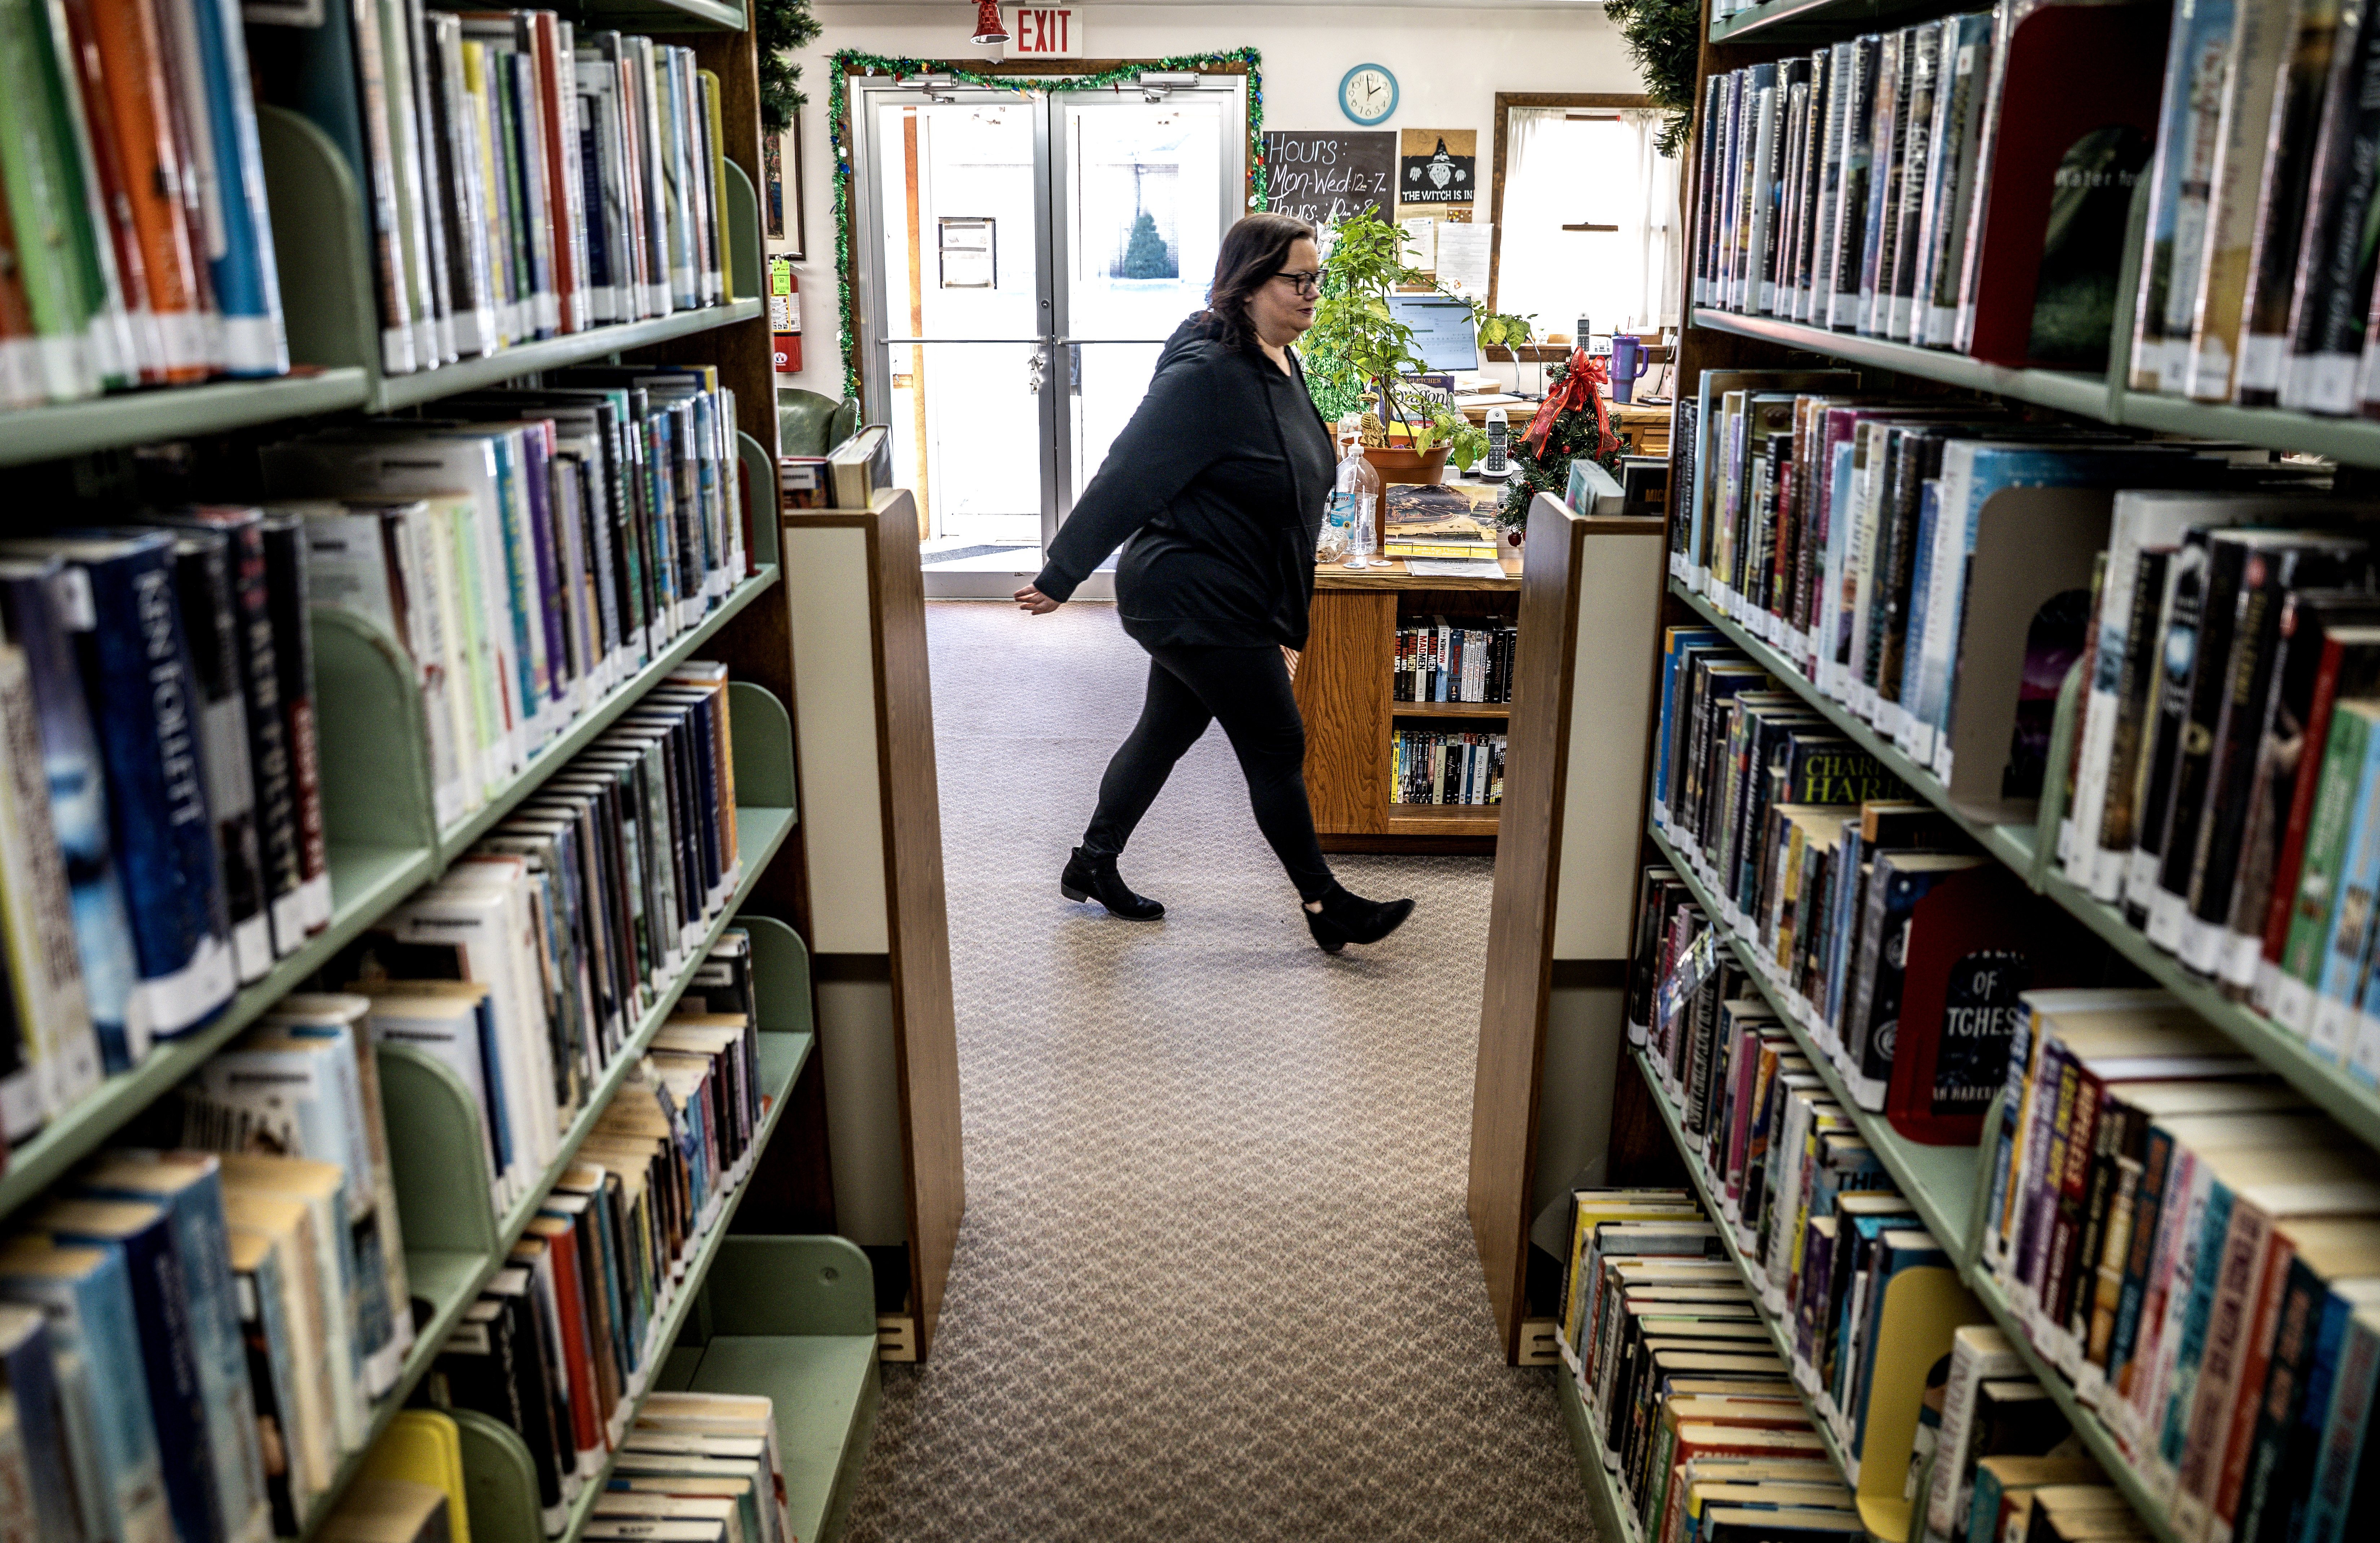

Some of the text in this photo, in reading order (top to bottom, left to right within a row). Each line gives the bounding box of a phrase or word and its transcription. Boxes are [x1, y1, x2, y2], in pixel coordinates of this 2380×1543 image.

[1018, 10, 1071, 52] EXIT
[1351, 99, 1357, 107] 8
[1374, 105, 1380, 114] 5
[1832, 84, 1848, 156] BRETHREN
[1771, 111, 1783, 173] GRISHAM
[1904, 123, 1929, 214] GRISHAM
[1402, 190, 1472, 201] THE WITCH IS IN
[1407, 655, 1416, 672] MEN
[1418, 653, 1426, 670] MEN
[1428, 655, 1436, 671] MEN
[1972, 970, 1998, 1001] OF
[1948, 1007, 2019, 1038] TCHES
[2064, 1081, 2096, 1185] HOPELESS
[2045, 1137, 2066, 1191] HOPE
